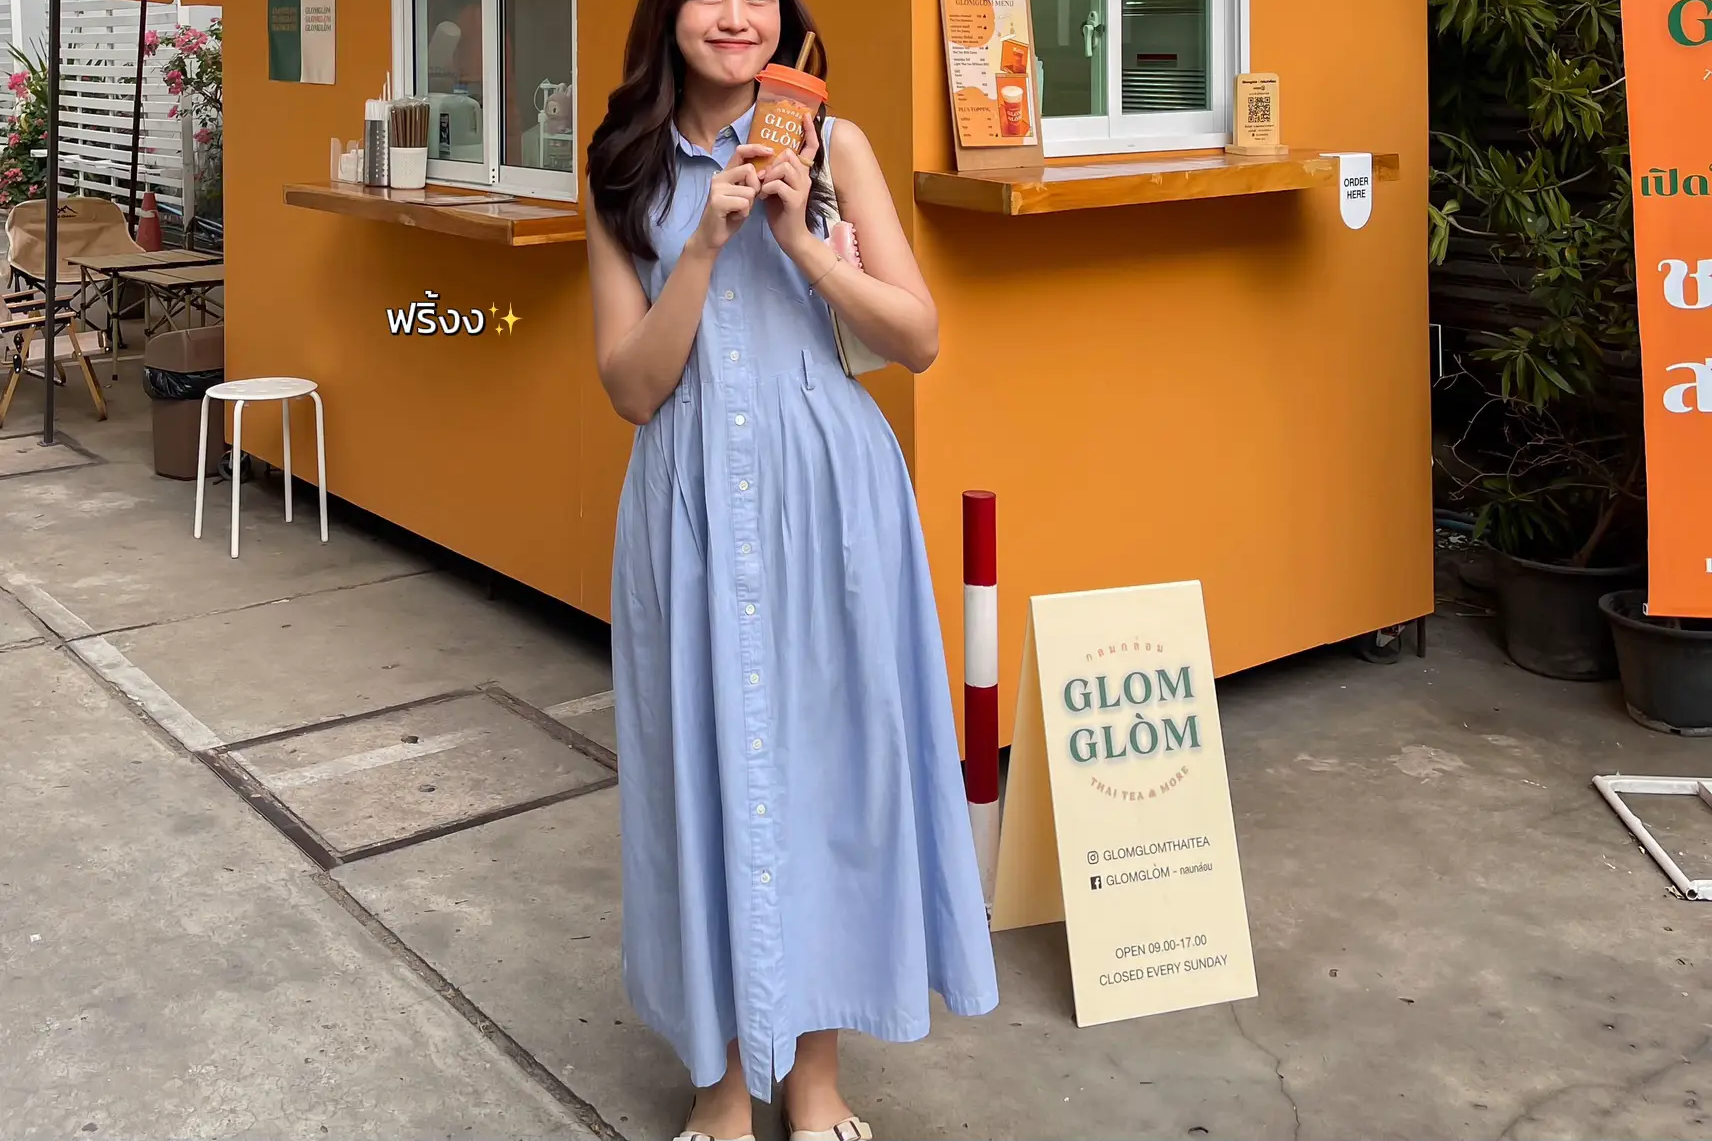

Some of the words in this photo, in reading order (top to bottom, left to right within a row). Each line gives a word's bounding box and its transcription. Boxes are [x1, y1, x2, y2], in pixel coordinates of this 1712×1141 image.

[1344, 177, 1369, 187] ORDER
[1347, 189, 1366, 199] HERE
[1086, 636, 1164, 662] กลมกล่อม
[1064, 666, 1195, 712] GLOM
[1069, 713, 1201, 763] GLÒM
[1090, 776, 1118, 799] THAI
[1122, 790, 1144, 801] TEA
[1160, 765, 1189, 794] MORE
[1103, 836, 1210, 861] GLOMGLOMTHAITEA
[1106, 864, 1170, 886] GLOMGLÒM
[1115, 945, 1146, 959] OPEN
[1148, 934, 1207, 954] 09.00-17.00
[1099, 969, 1144, 986] CLOSED
[1146, 962, 1181, 978] EVERY
[1184, 954, 1228, 972] SUNDAY
